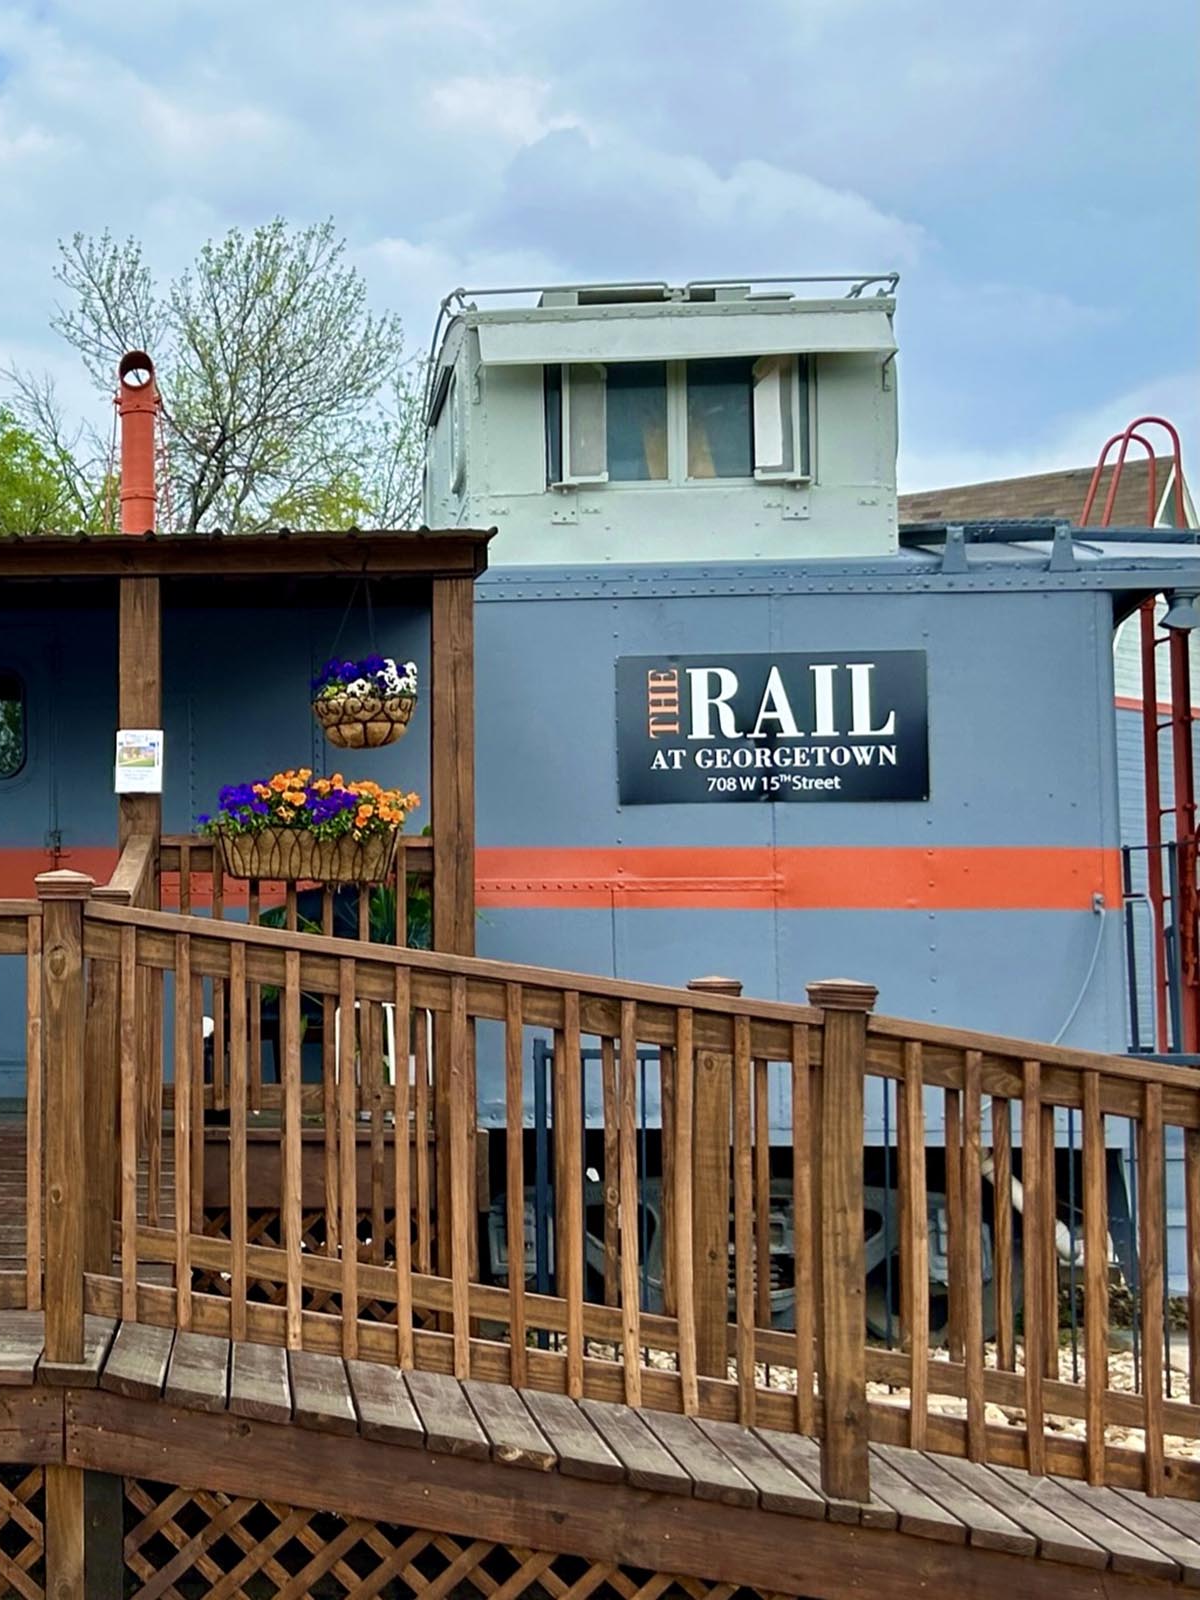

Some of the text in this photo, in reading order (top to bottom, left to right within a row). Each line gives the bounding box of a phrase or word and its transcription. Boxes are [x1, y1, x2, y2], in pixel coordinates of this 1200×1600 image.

[648, 668, 680, 739] THE
[685, 663, 896, 740] RAIL
[650, 744, 897, 770] AT GEORGETOWN
[707, 776, 738, 792] 708
[739, 776, 757, 791] W
